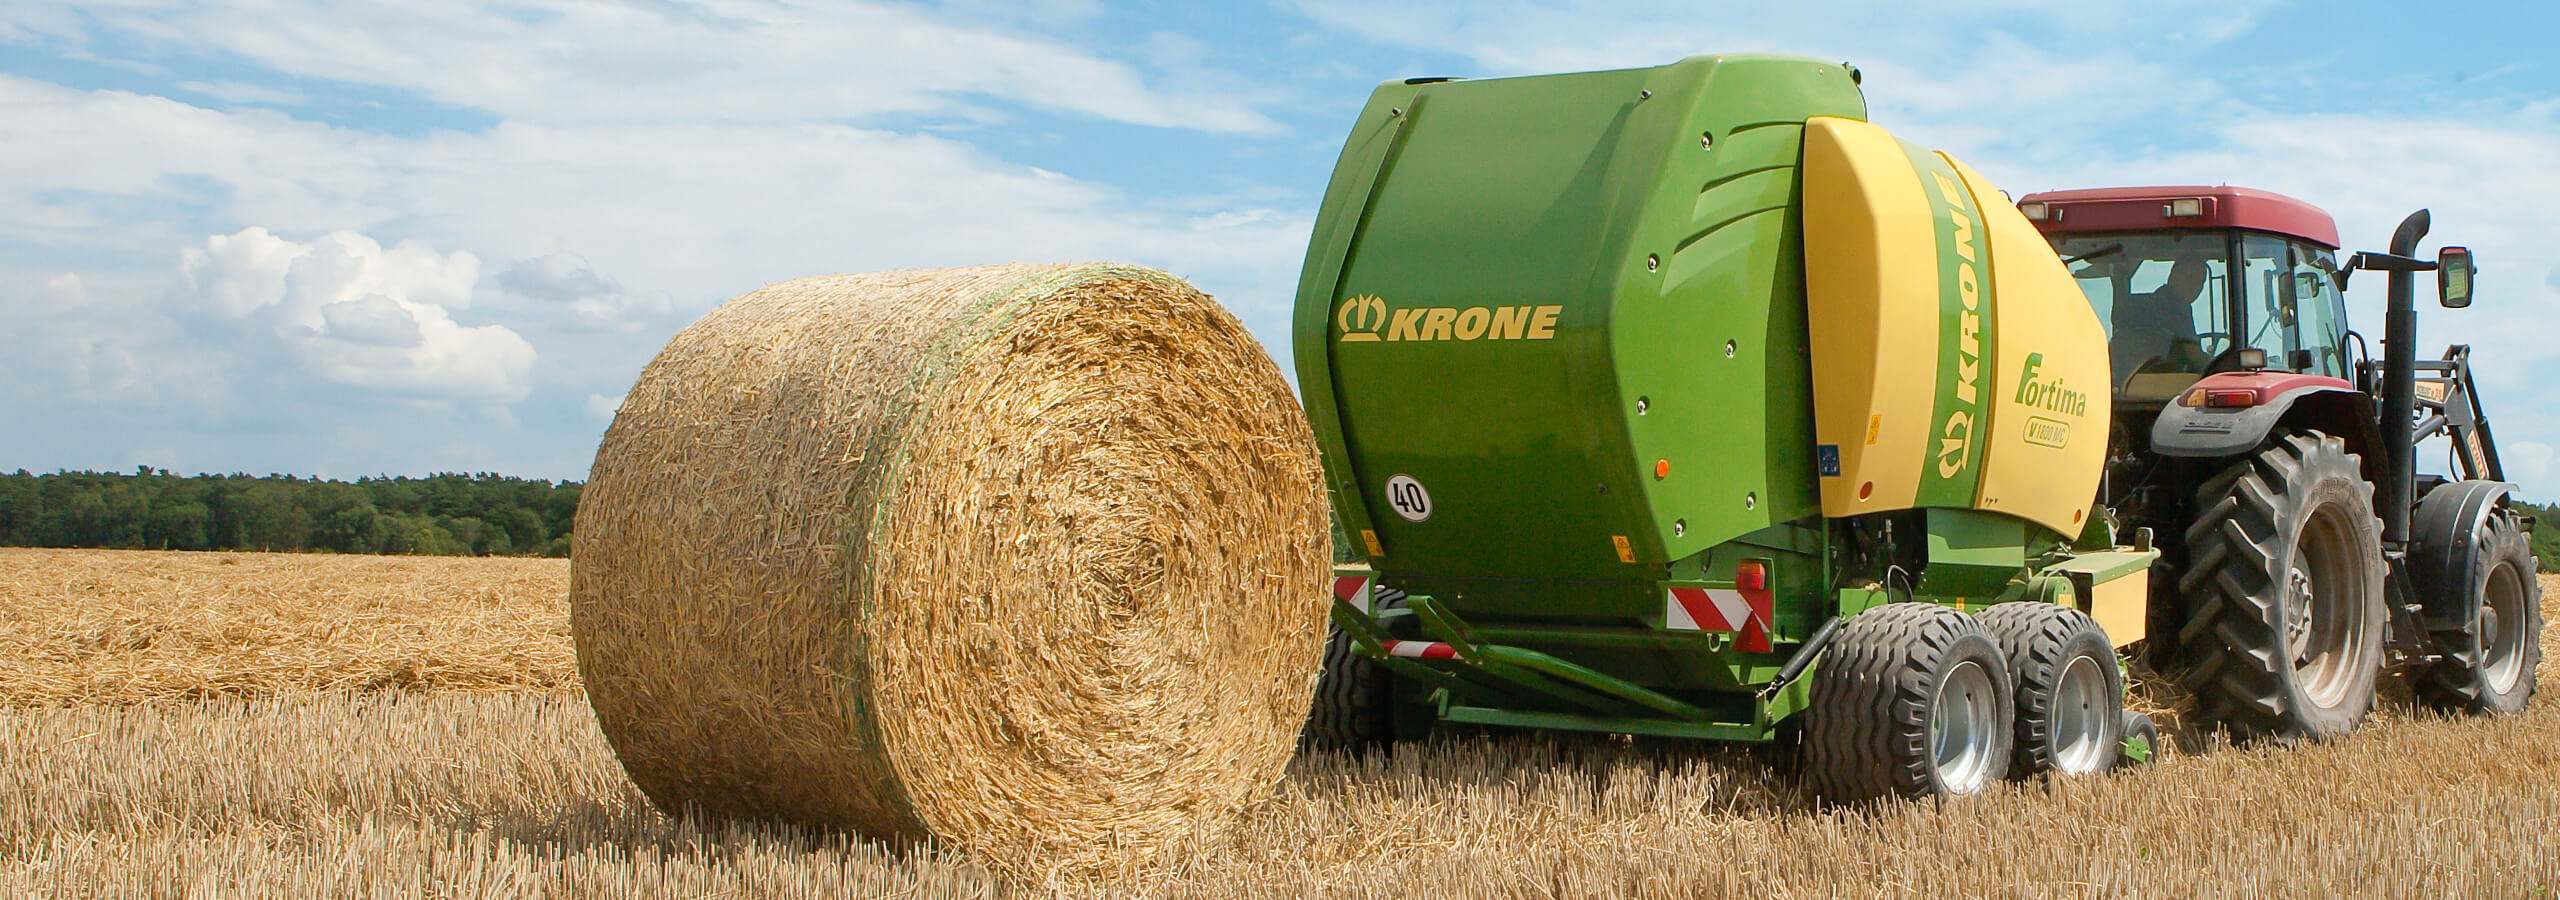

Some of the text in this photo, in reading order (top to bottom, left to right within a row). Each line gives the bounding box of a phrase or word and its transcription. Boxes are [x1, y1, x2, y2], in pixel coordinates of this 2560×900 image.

[1931, 170, 1979, 405] KRONE
[1387, 305, 1563, 341] KRONE
[2015, 352, 2086, 417] Fortima
[2029, 422, 2038, 437] V
[1393, 483, 1425, 513] 40
